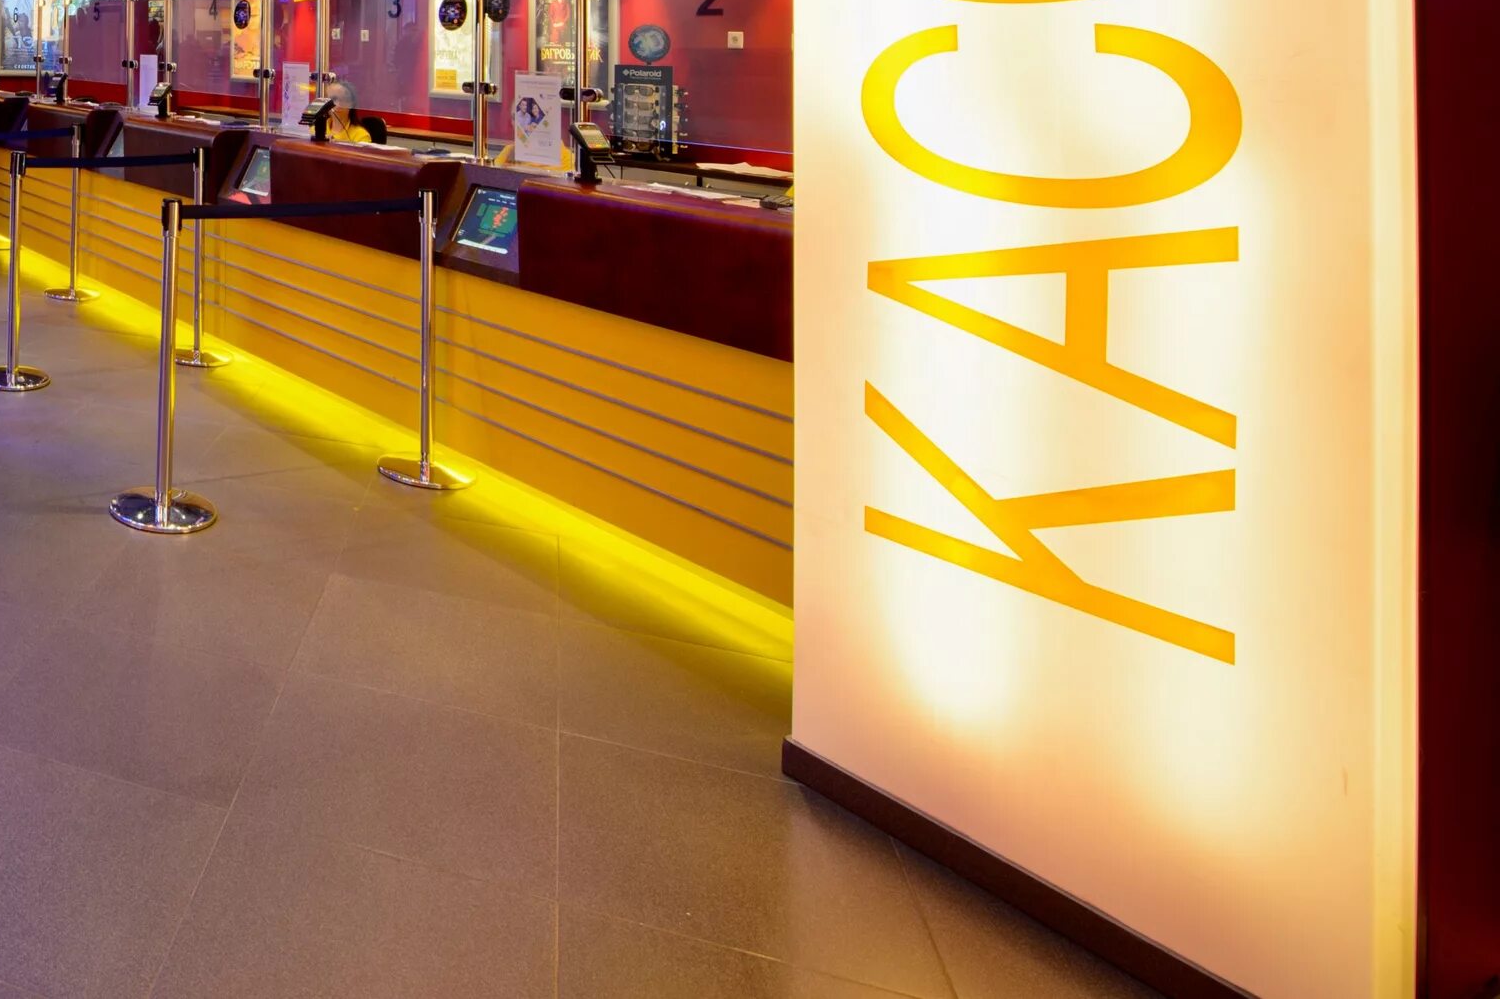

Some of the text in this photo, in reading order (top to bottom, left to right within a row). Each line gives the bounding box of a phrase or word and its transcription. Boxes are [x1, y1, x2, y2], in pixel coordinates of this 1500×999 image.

[13, 7, 19, 23] 6
[93, 3, 100, 21] 5
[540, 47, 576, 60] БАГРОВ
[630, 69, 662, 77] Polaroid
